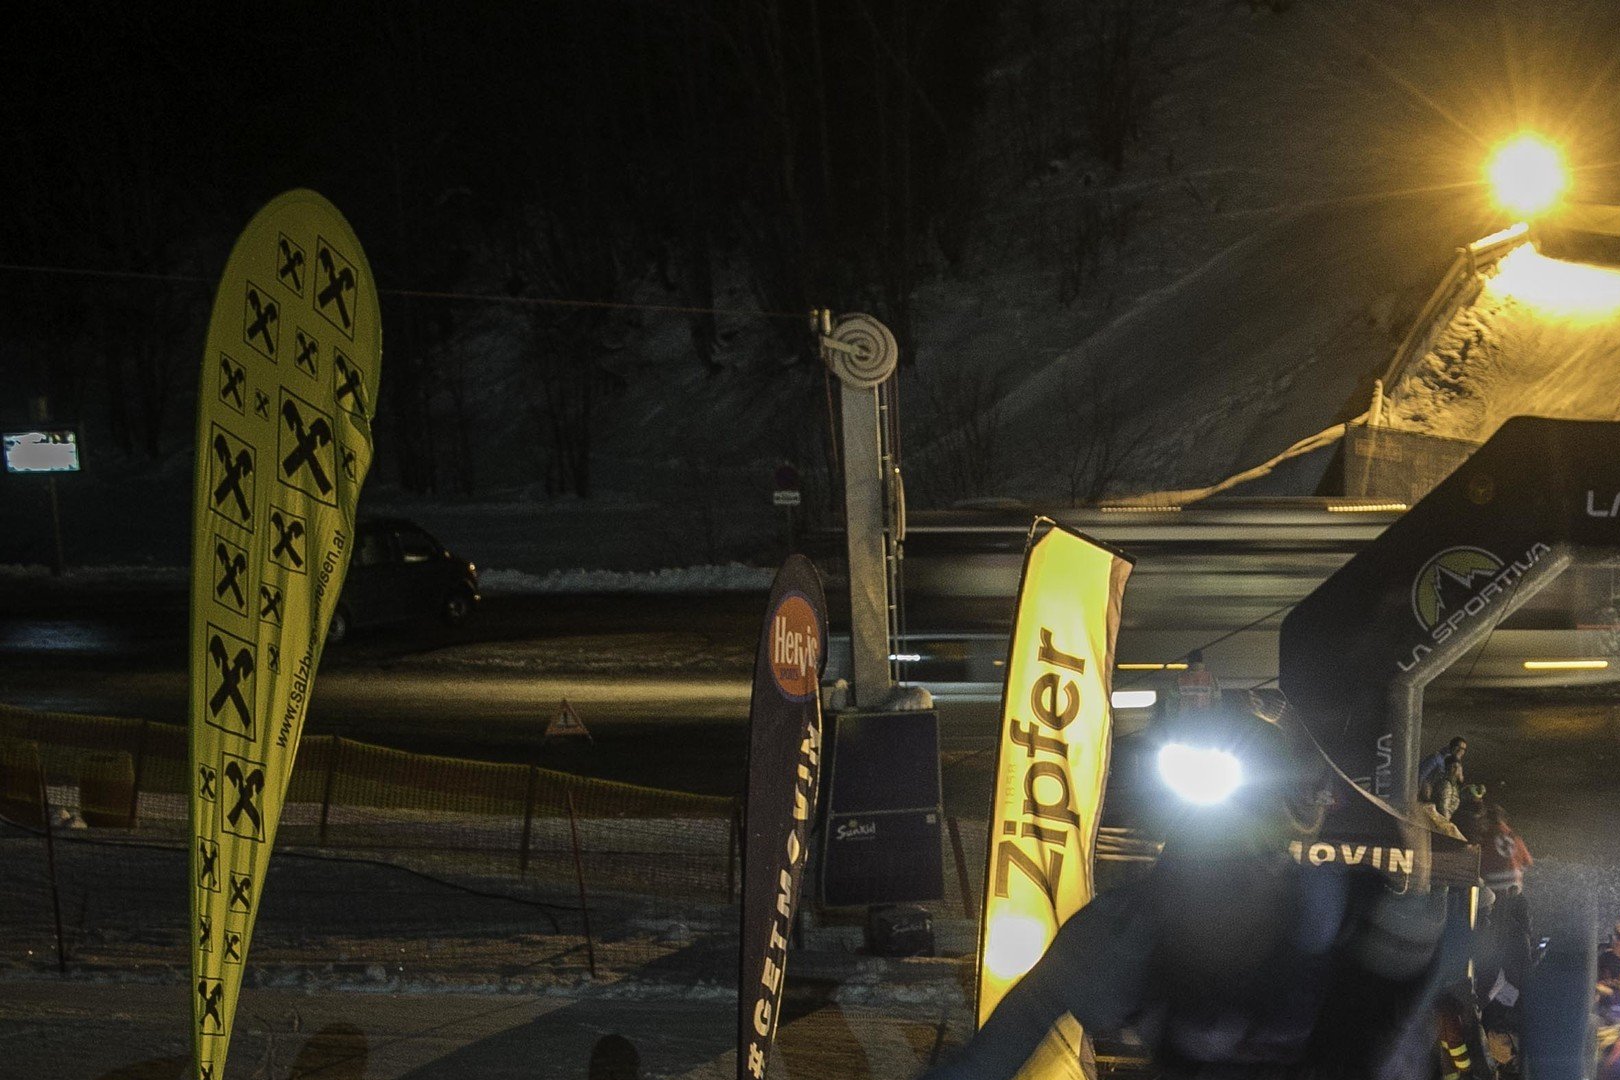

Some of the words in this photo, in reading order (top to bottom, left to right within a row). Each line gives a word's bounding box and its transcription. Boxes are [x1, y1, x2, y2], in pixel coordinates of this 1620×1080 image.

[774, 615, 818, 678] Hervis
[1397, 644, 1433, 672] LA
[1432, 542, 1551, 644] SPORTIVA
[995, 627, 1086, 911] Zipfer
